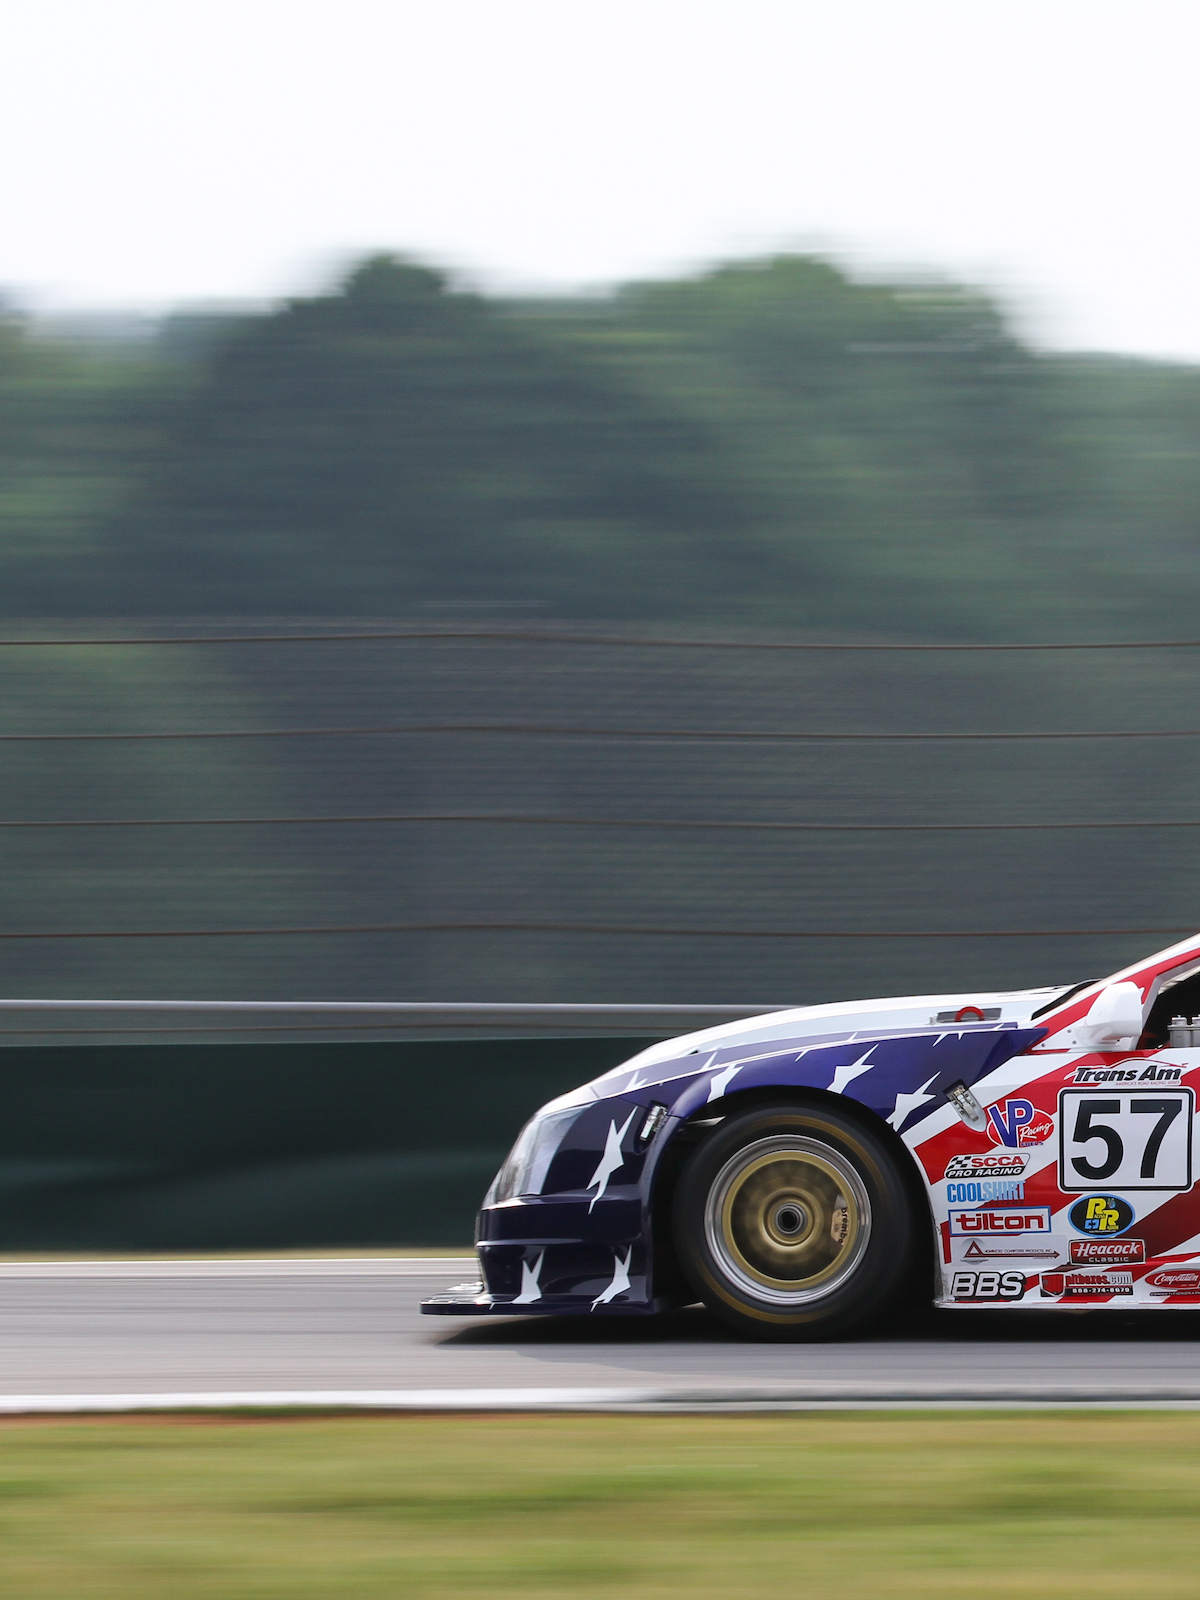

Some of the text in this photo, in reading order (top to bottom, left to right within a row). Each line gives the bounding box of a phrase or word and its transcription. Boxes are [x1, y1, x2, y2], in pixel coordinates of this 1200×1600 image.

[1074, 1065, 1181, 1082] Trans Am
[988, 1100, 1033, 1147] VP
[1020, 1122, 1053, 1140] Racing
[1071, 1099, 1182, 1180] 57
[971, 1156, 1024, 1167] SCCA
[948, 1167, 1022, 1177] PRO RACING
[947, 1181, 1025, 1203] COOLSHIRT
[956, 1213, 1043, 1230] tilton
[1074, 1242, 1140, 1257] Heacock
[952, 1272, 1024, 1298] BBS
[1154, 1273, 1199, 1285] Competition
